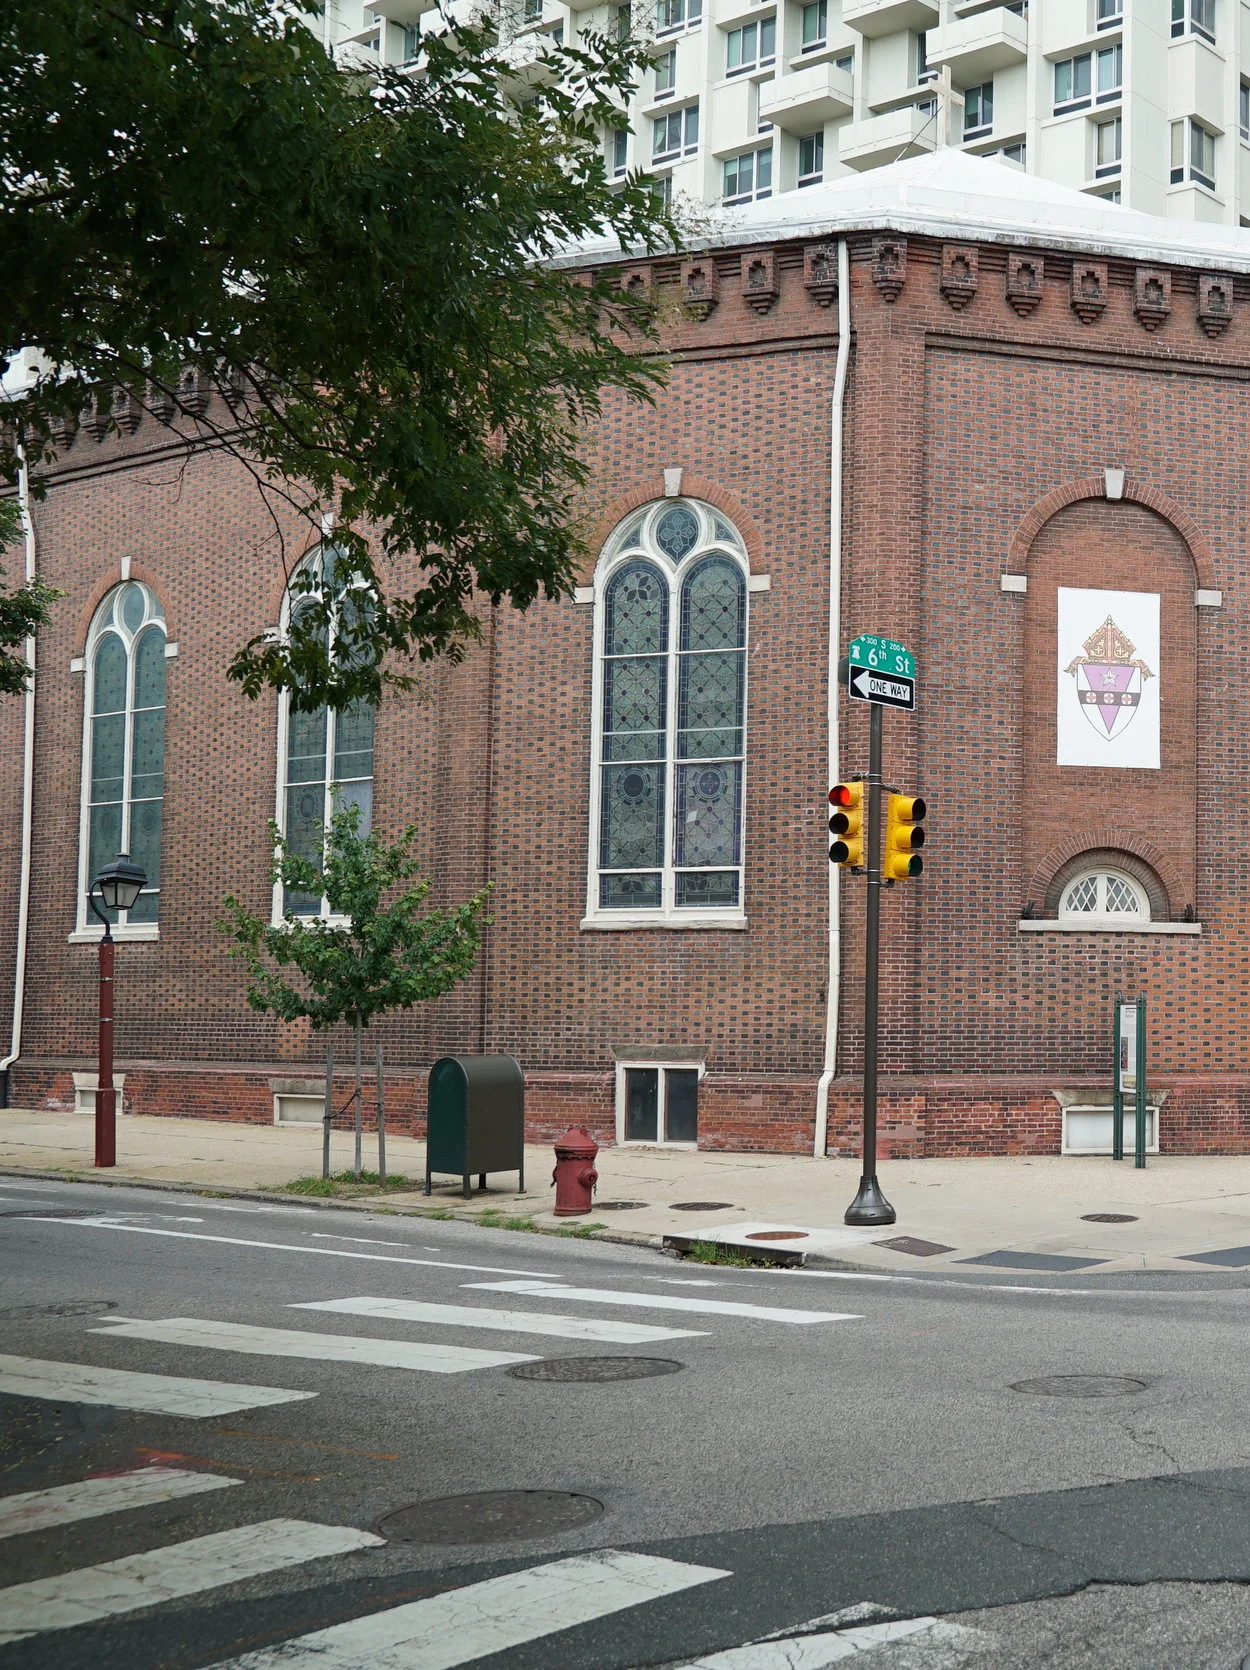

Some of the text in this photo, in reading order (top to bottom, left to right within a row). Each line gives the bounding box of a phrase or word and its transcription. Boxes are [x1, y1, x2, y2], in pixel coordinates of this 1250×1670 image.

[865, 637, 901, 651] 300 S 200
[868, 648, 910, 674] 6th St
[870, 679, 908, 699] ONE WAY
